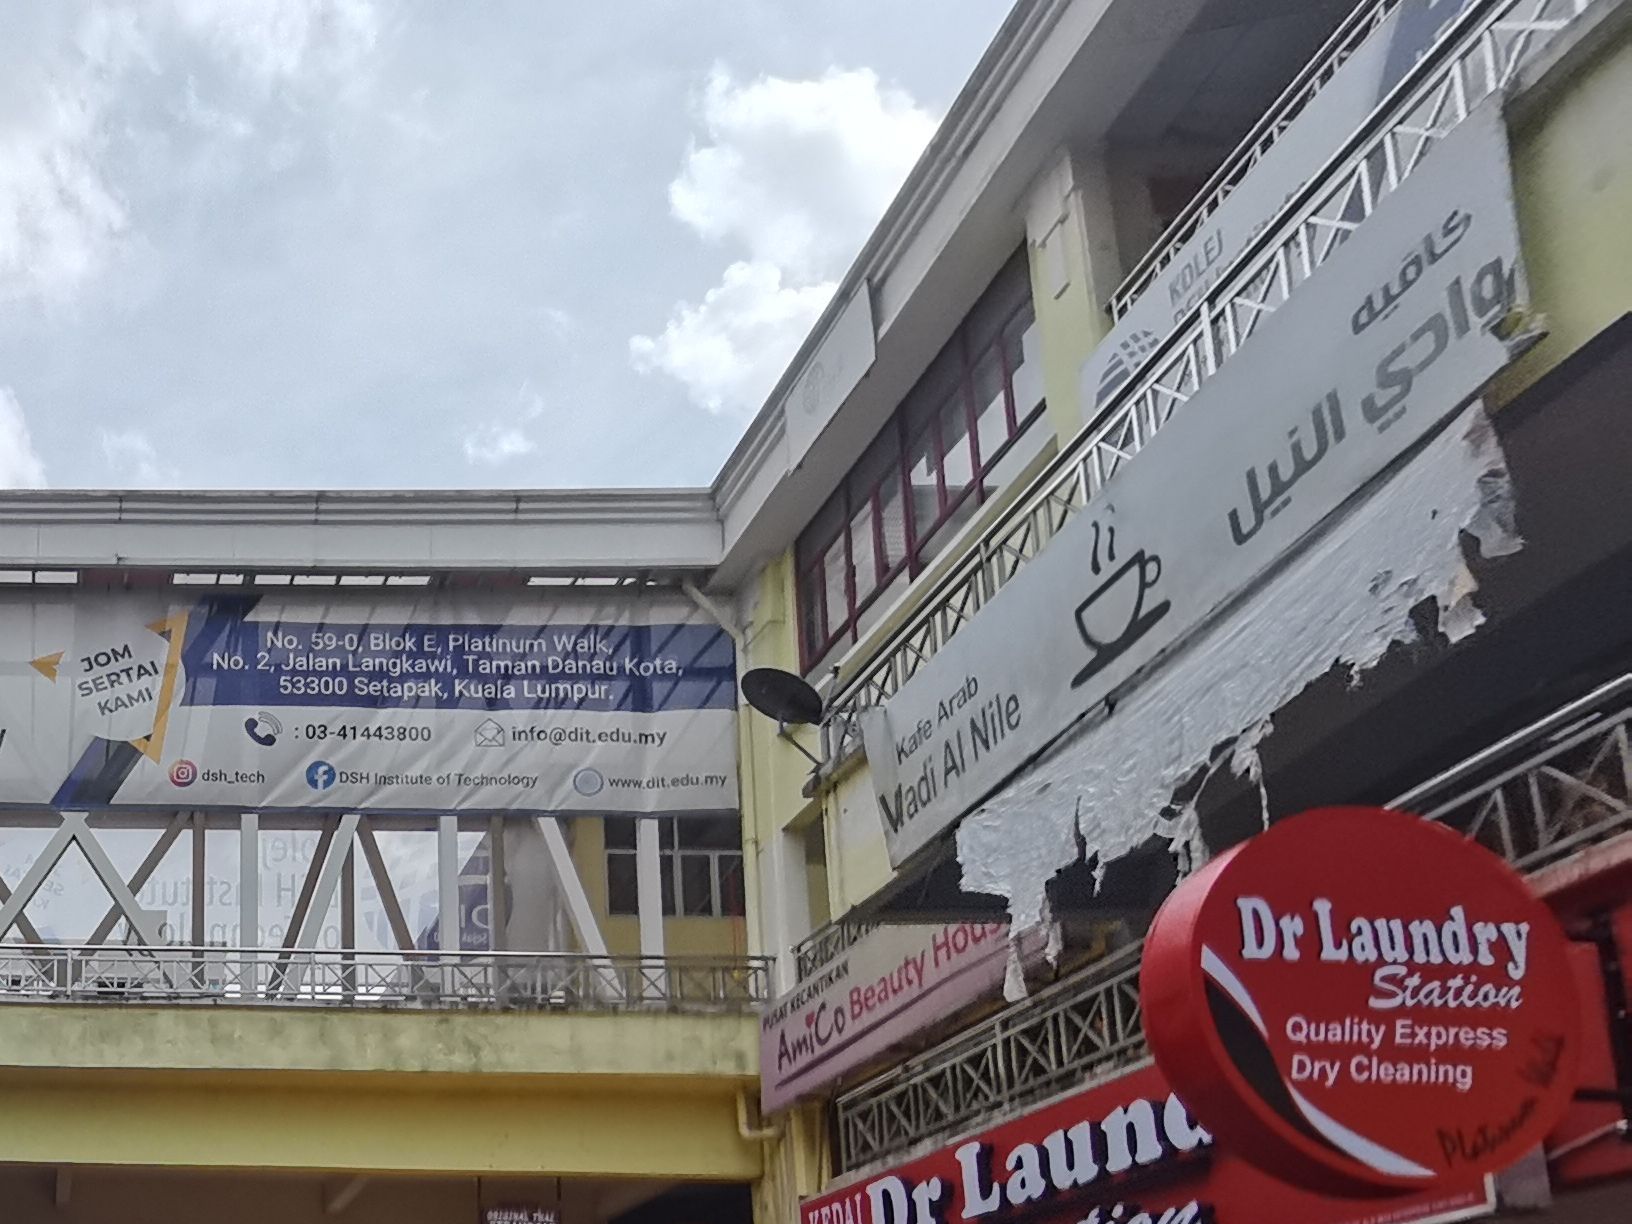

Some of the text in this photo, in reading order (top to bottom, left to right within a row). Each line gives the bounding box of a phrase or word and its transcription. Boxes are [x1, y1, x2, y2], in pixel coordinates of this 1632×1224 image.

[1168, 227, 1224, 307] KOLEJ
[1226, 388, 1346, 547] النيل
[79, 643, 134, 674] JOM
[266, 632, 304, 650] No.
[369, 633, 417, 652] Blok
[423, 633, 443, 654] E,
[448, 633, 546, 653] Platinum
[553, 634, 614, 656] Walk,
[76, 659, 161, 698] SERTAI
[211, 651, 684, 678] No. 2, Jalan Langkawi, Taman Danau Kota,
[96, 686, 154, 717] KAMI
[278, 676, 615, 703] 53300 Setapak, Kuala Lumpur.
[305, 723, 432, 742] 03-41443800
[511, 725, 667, 747] info@dit.edu.my
[895, 675, 979, 767] Kafe Arab
[943, 729, 966, 789] Al
[969, 693, 1022, 764] Nile
[201, 769, 728, 790] dsh_tech DSH Institute of Technology www.dit.edu.my
[1235, 895, 1531, 981] Dr Laundry
[777, 919, 1004, 1075] AmiCo Beauty Hous
[1367, 964, 1524, 1012] Station
[1285, 1015, 1509, 1051] Quality Express
[1290, 1053, 1474, 1092] Dry Cleaning
[954, 1091, 1215, 1221] Laund
